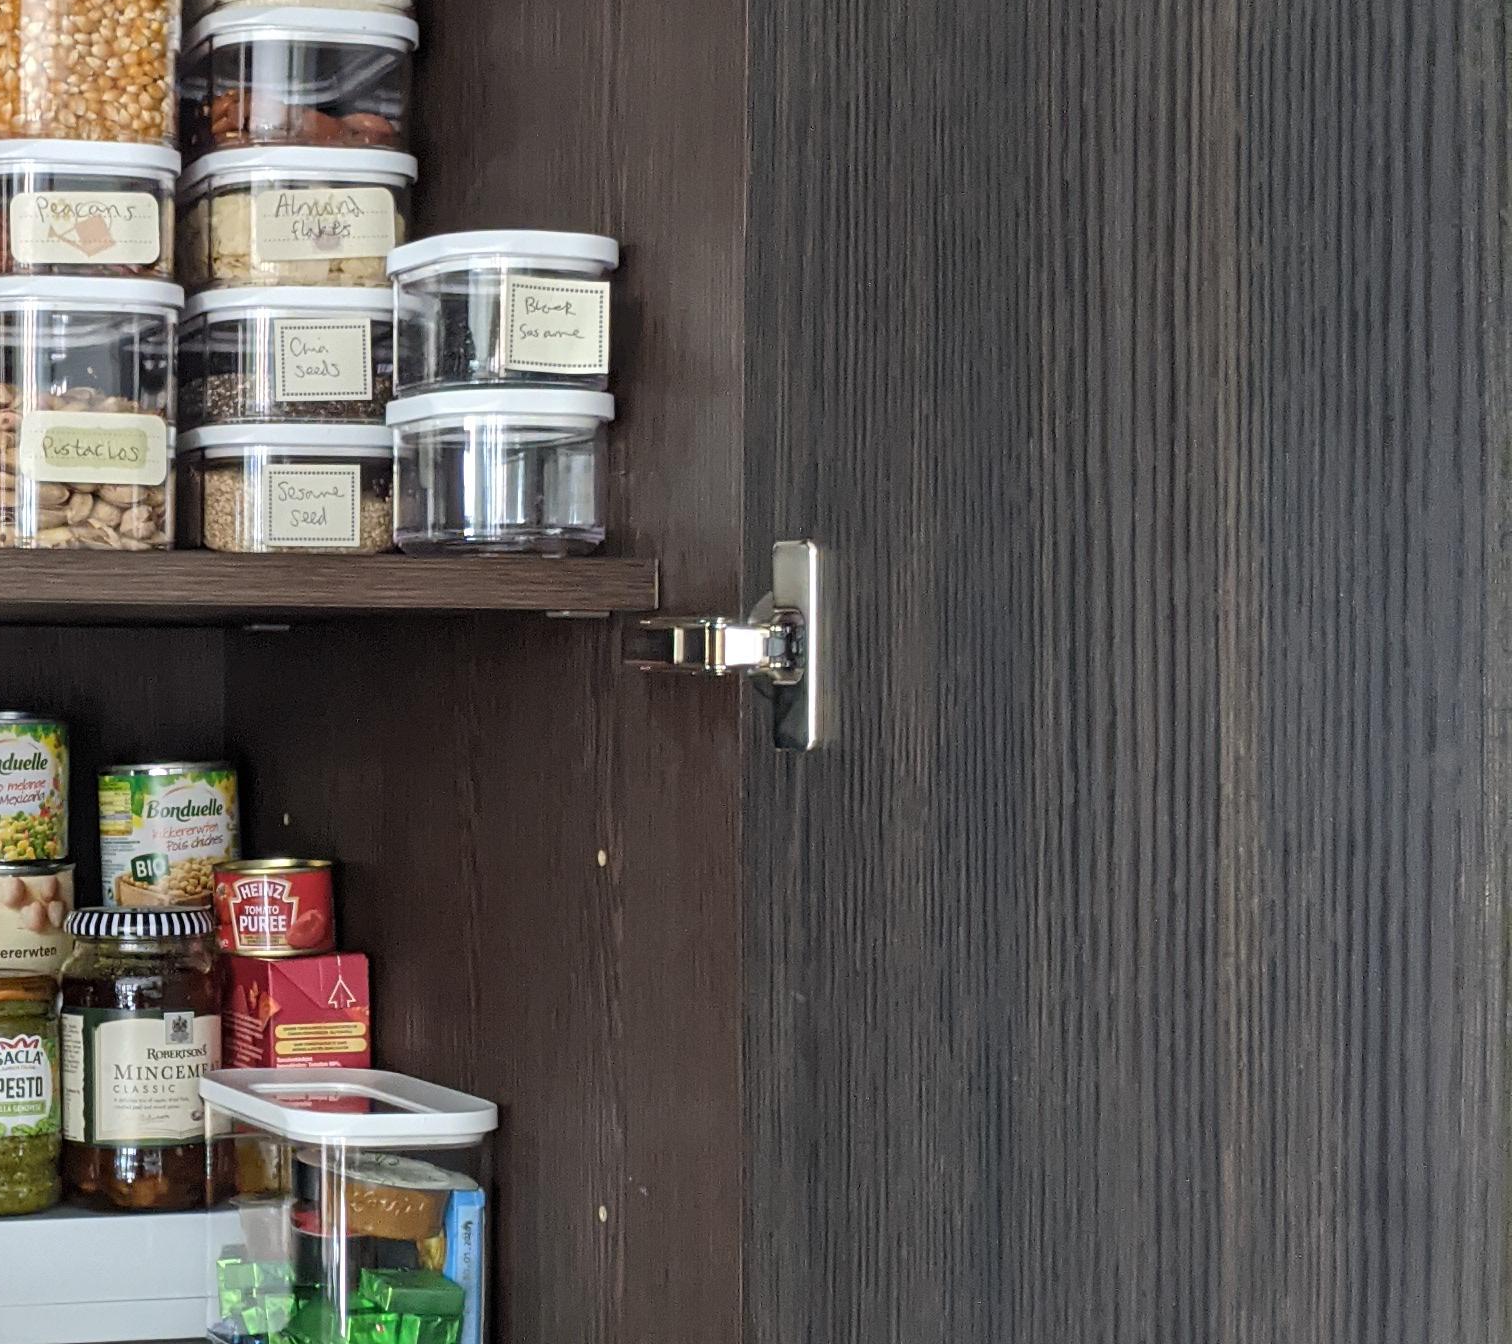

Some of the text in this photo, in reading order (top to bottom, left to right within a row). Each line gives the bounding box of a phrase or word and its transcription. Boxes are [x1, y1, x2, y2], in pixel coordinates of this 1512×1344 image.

[274, 193, 365, 218] Almond
[145, 798, 224, 823] Bonduelle
[134, 858, 166, 879] BIO
[239, 883, 285, 901] HEINZ
[243, 904, 280, 916] TOMATO
[239, 914, 288, 933] PUREE
[112, 1084, 177, 1095] CLASSIC
